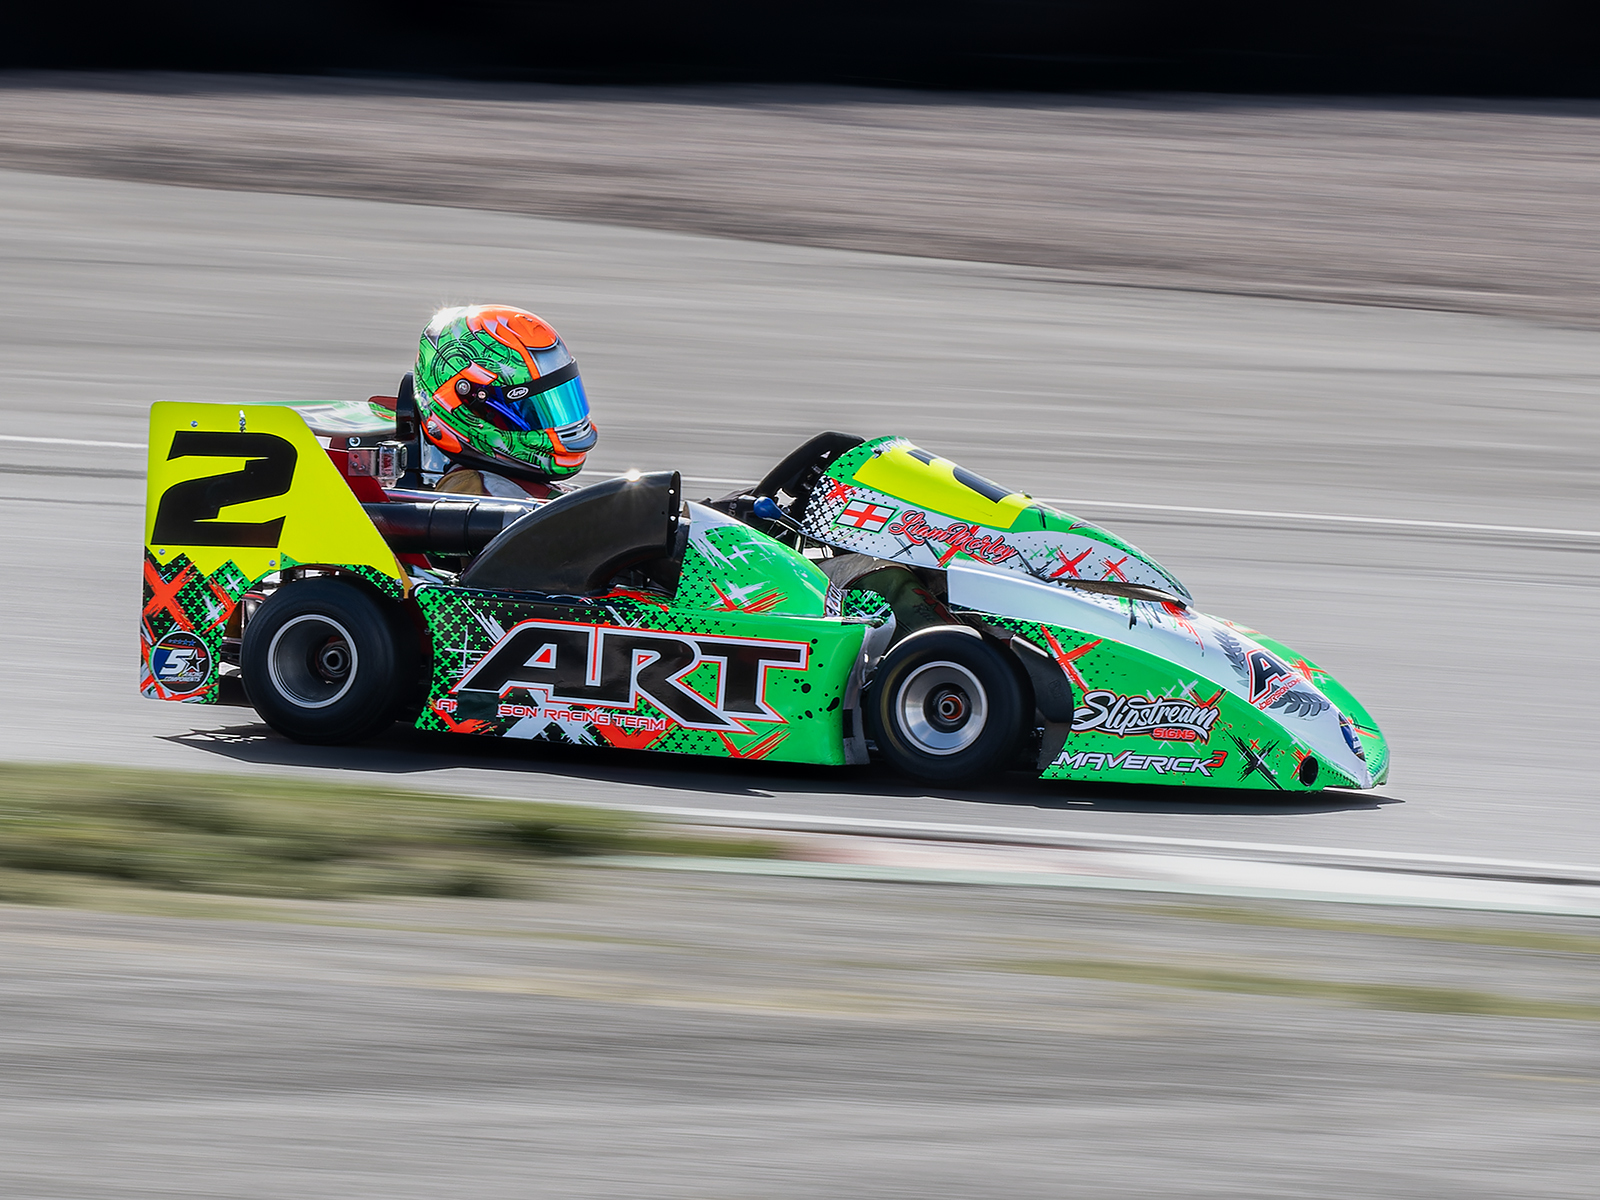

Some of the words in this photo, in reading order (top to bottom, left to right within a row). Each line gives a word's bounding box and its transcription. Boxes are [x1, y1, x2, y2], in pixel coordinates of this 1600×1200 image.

[150, 430, 298, 548] 2
[888, 510, 948, 546] Liam
[946, 522, 1019, 564] Morley
[455, 621, 807, 732] ART
[543, 706, 610, 725] RACING
[614, 715, 666, 731] TEAM
[1071, 690, 1219, 739] Slipstream
[1153, 728, 1196, 740] SIGNS
